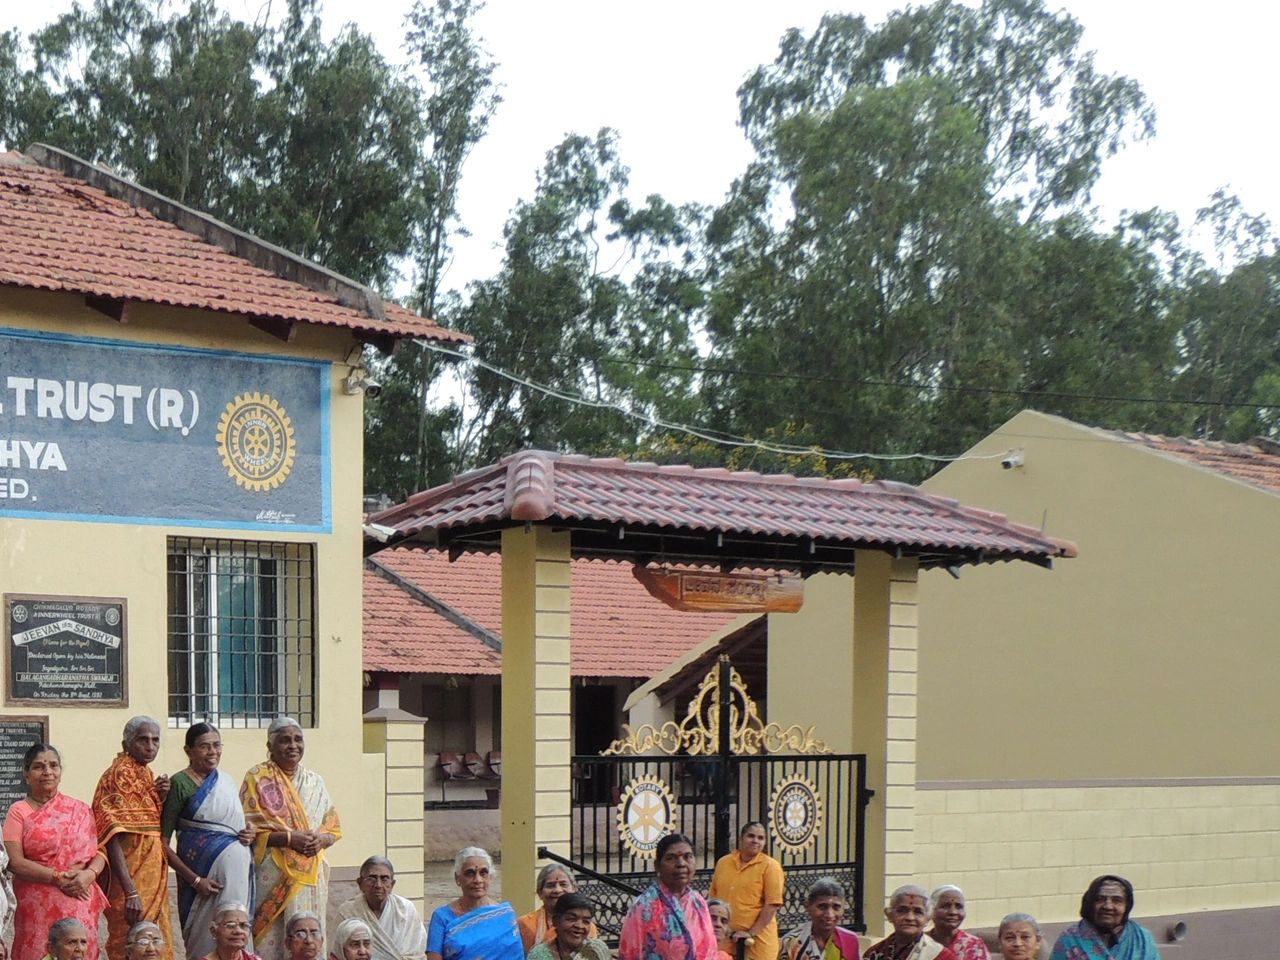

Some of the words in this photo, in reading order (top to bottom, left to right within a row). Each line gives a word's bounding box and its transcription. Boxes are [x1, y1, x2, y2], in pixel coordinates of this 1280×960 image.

[7, 376, 142, 424] TRUST
[23, 623, 61, 641] JEEVAN
[74, 623, 114, 645] SANDHYA
